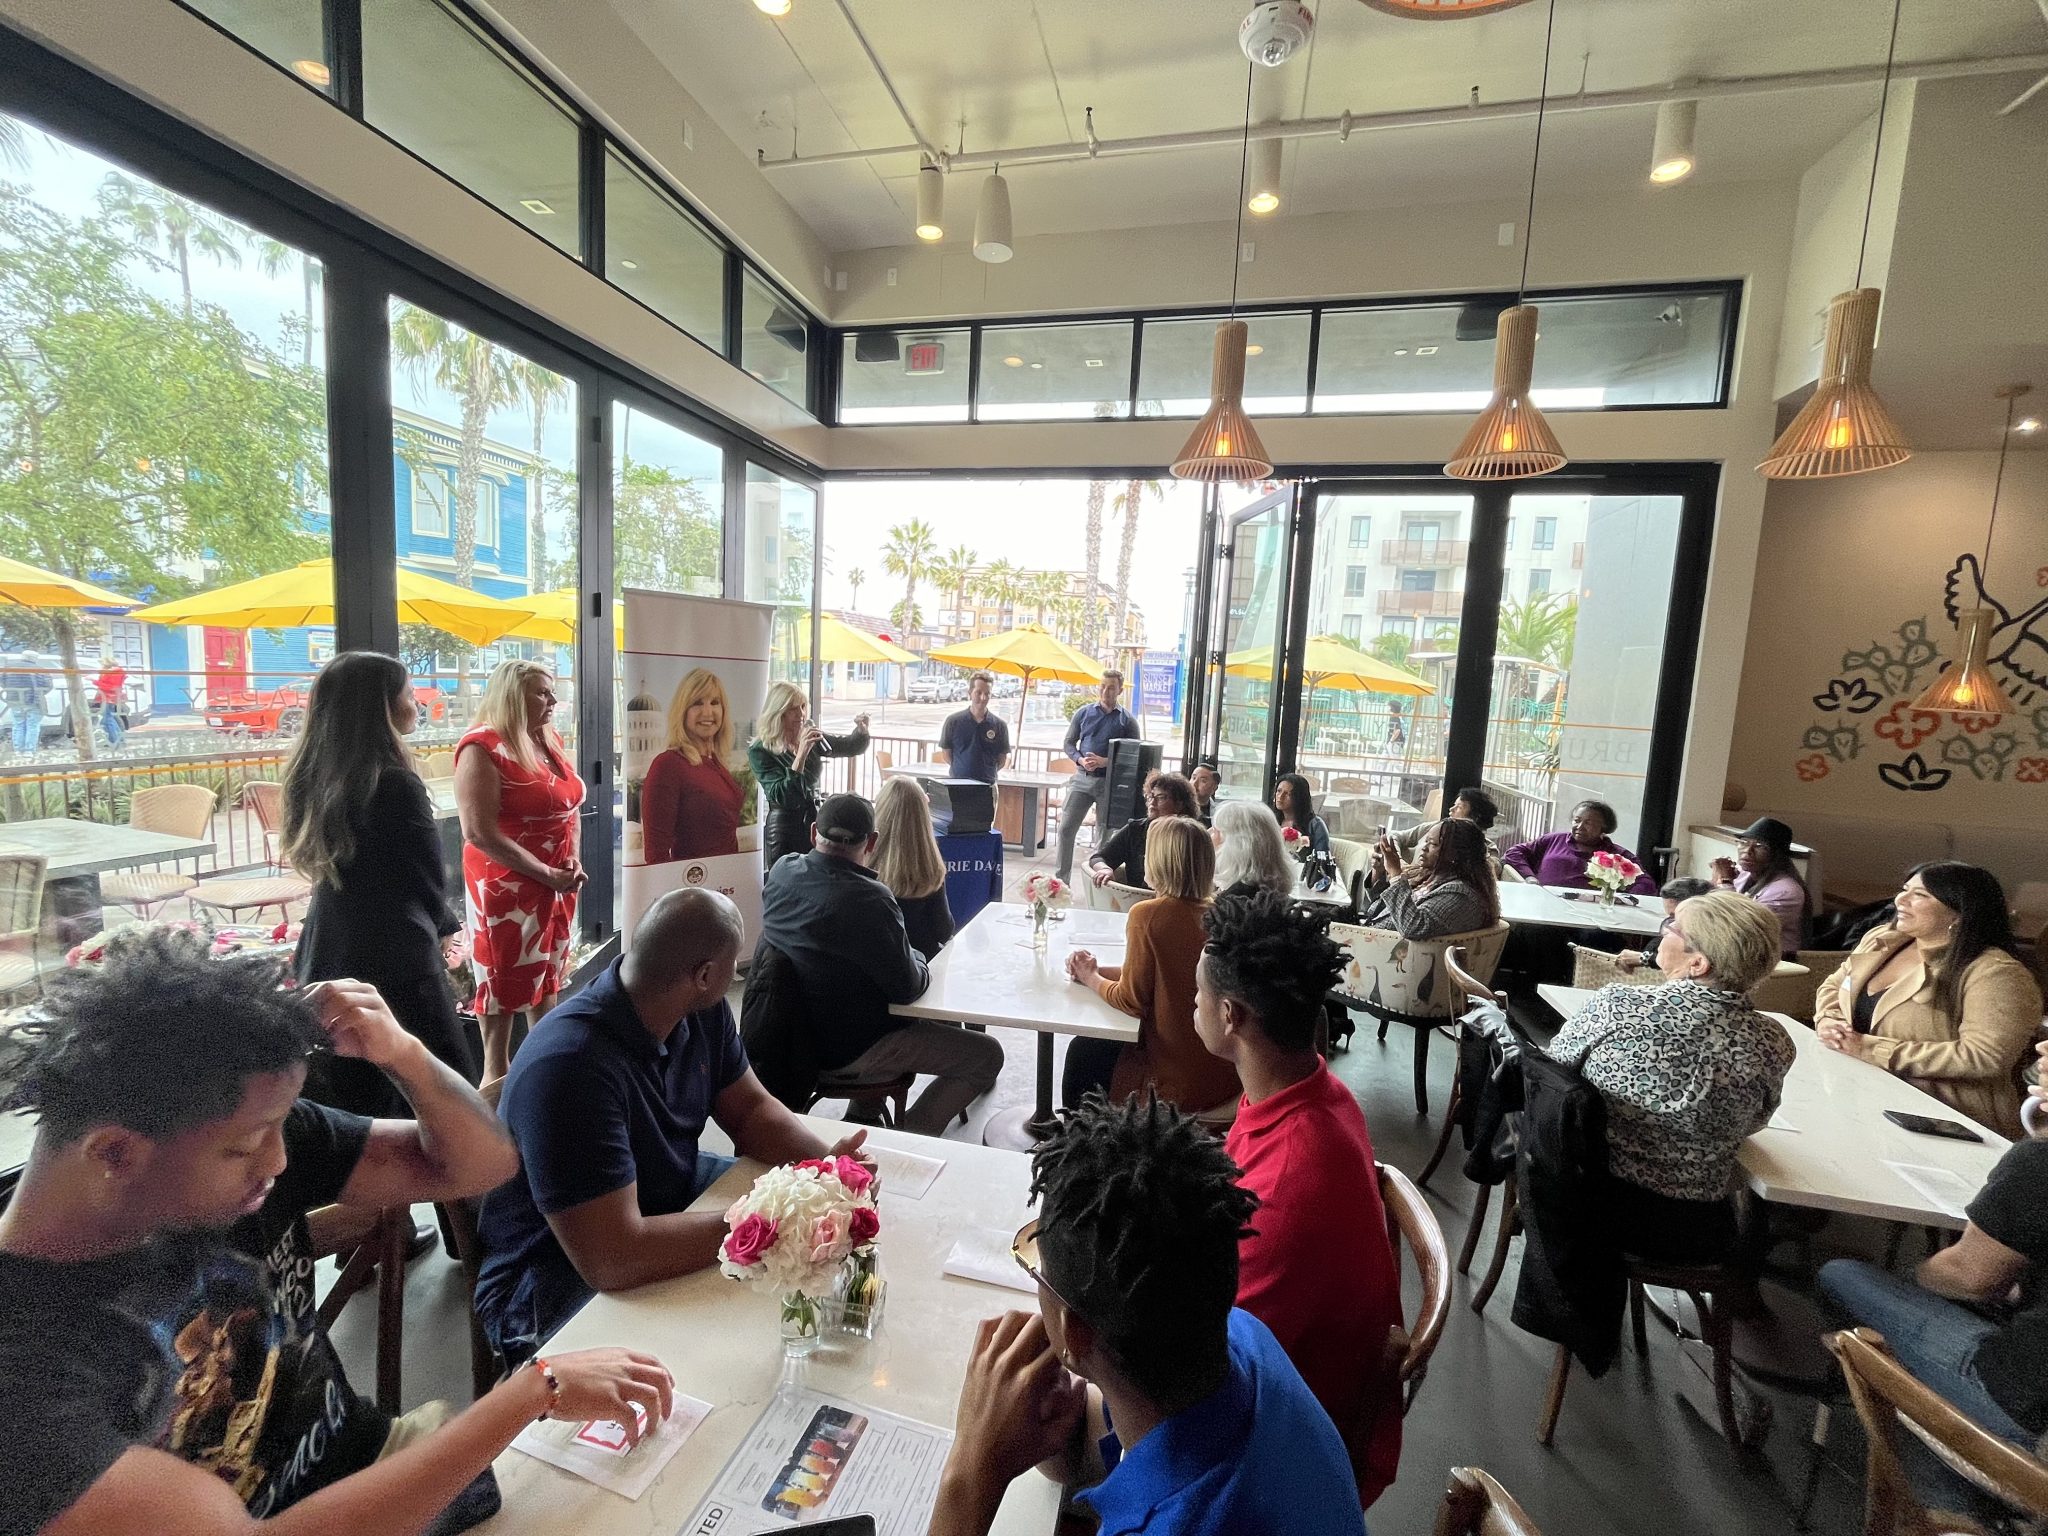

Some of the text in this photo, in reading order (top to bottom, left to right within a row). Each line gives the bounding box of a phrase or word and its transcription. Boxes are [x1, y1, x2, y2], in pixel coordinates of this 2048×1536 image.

[911, 346, 939, 369] EXIT
[1143, 682, 1171, 693] MARKET
[945, 860, 971, 872] RIE
[716, 885, 736, 896] ies
